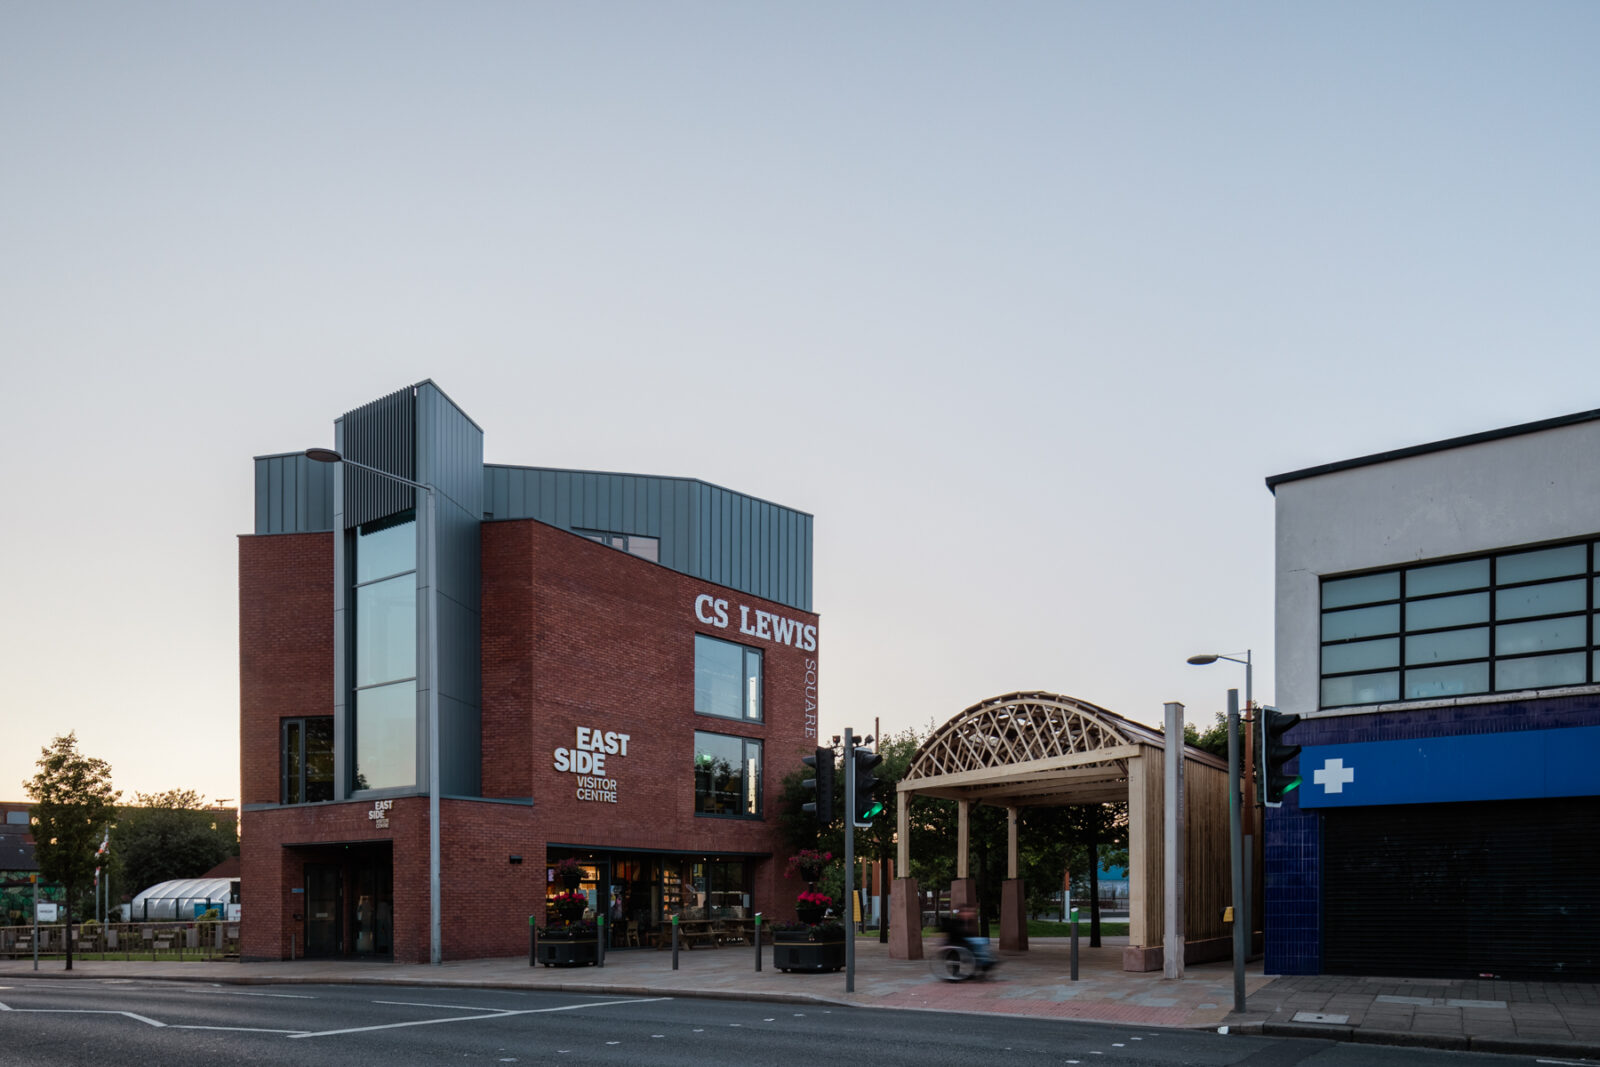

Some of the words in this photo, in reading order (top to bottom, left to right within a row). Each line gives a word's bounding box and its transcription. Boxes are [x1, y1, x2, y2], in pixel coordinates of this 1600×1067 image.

[694, 593, 729, 629] CS
[739, 604, 817, 652] LEWIS
[805, 658, 817, 739] SQUARE
[576, 726, 630, 757] EAST
[553, 747, 606, 776] SIDE
[577, 775, 617, 791] VISITOR
[375, 800, 393, 810] EAST
[576, 788, 617, 803] CENTRE
[368, 810, 385, 820] SIDE
